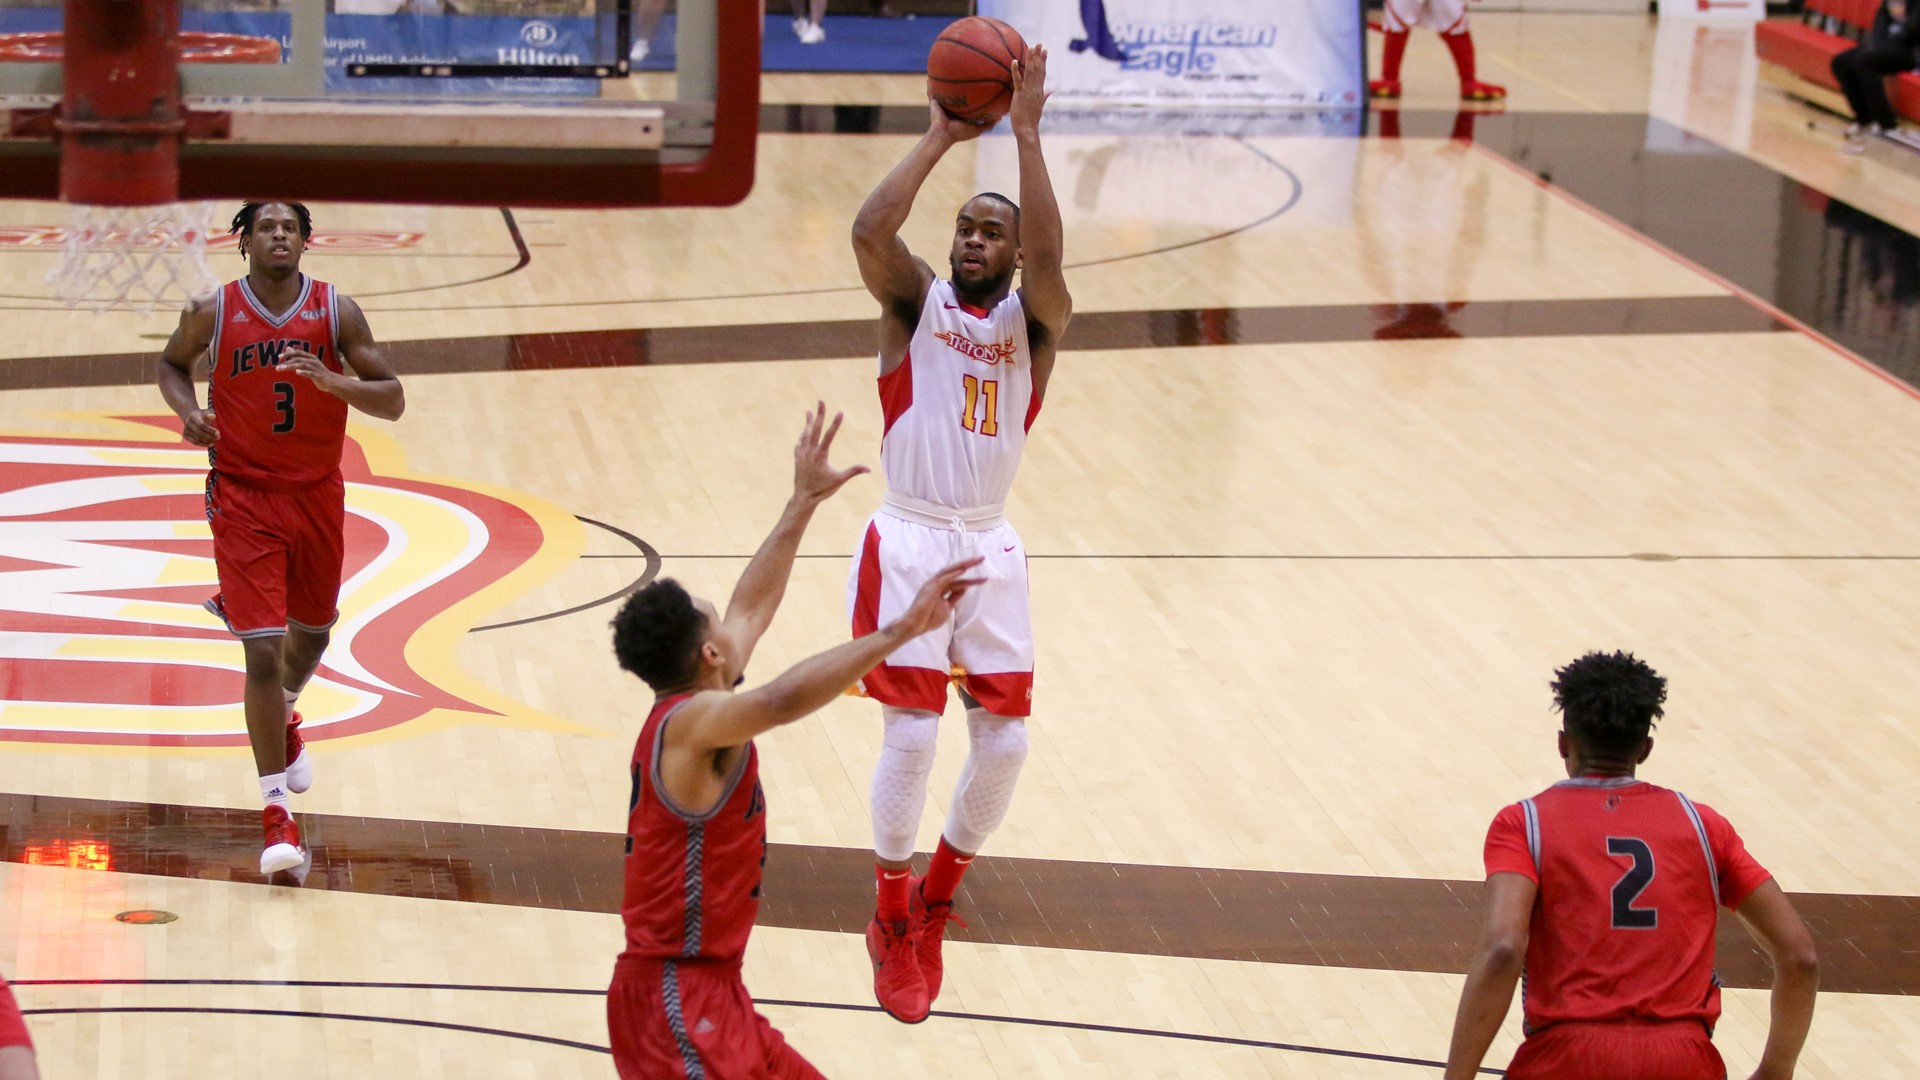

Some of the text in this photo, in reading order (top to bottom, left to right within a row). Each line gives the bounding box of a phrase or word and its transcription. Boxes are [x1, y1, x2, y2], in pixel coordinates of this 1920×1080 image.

[498, 48, 579, 65] Hilton
[1111, 21, 1276, 47] American
[1119, 30, 1216, 77] Eagle
[947, 331, 1001, 366] TRITONS
[272, 381, 296, 434] 3
[961, 373, 998, 437] 11
[1605, 835, 1658, 930] 2
